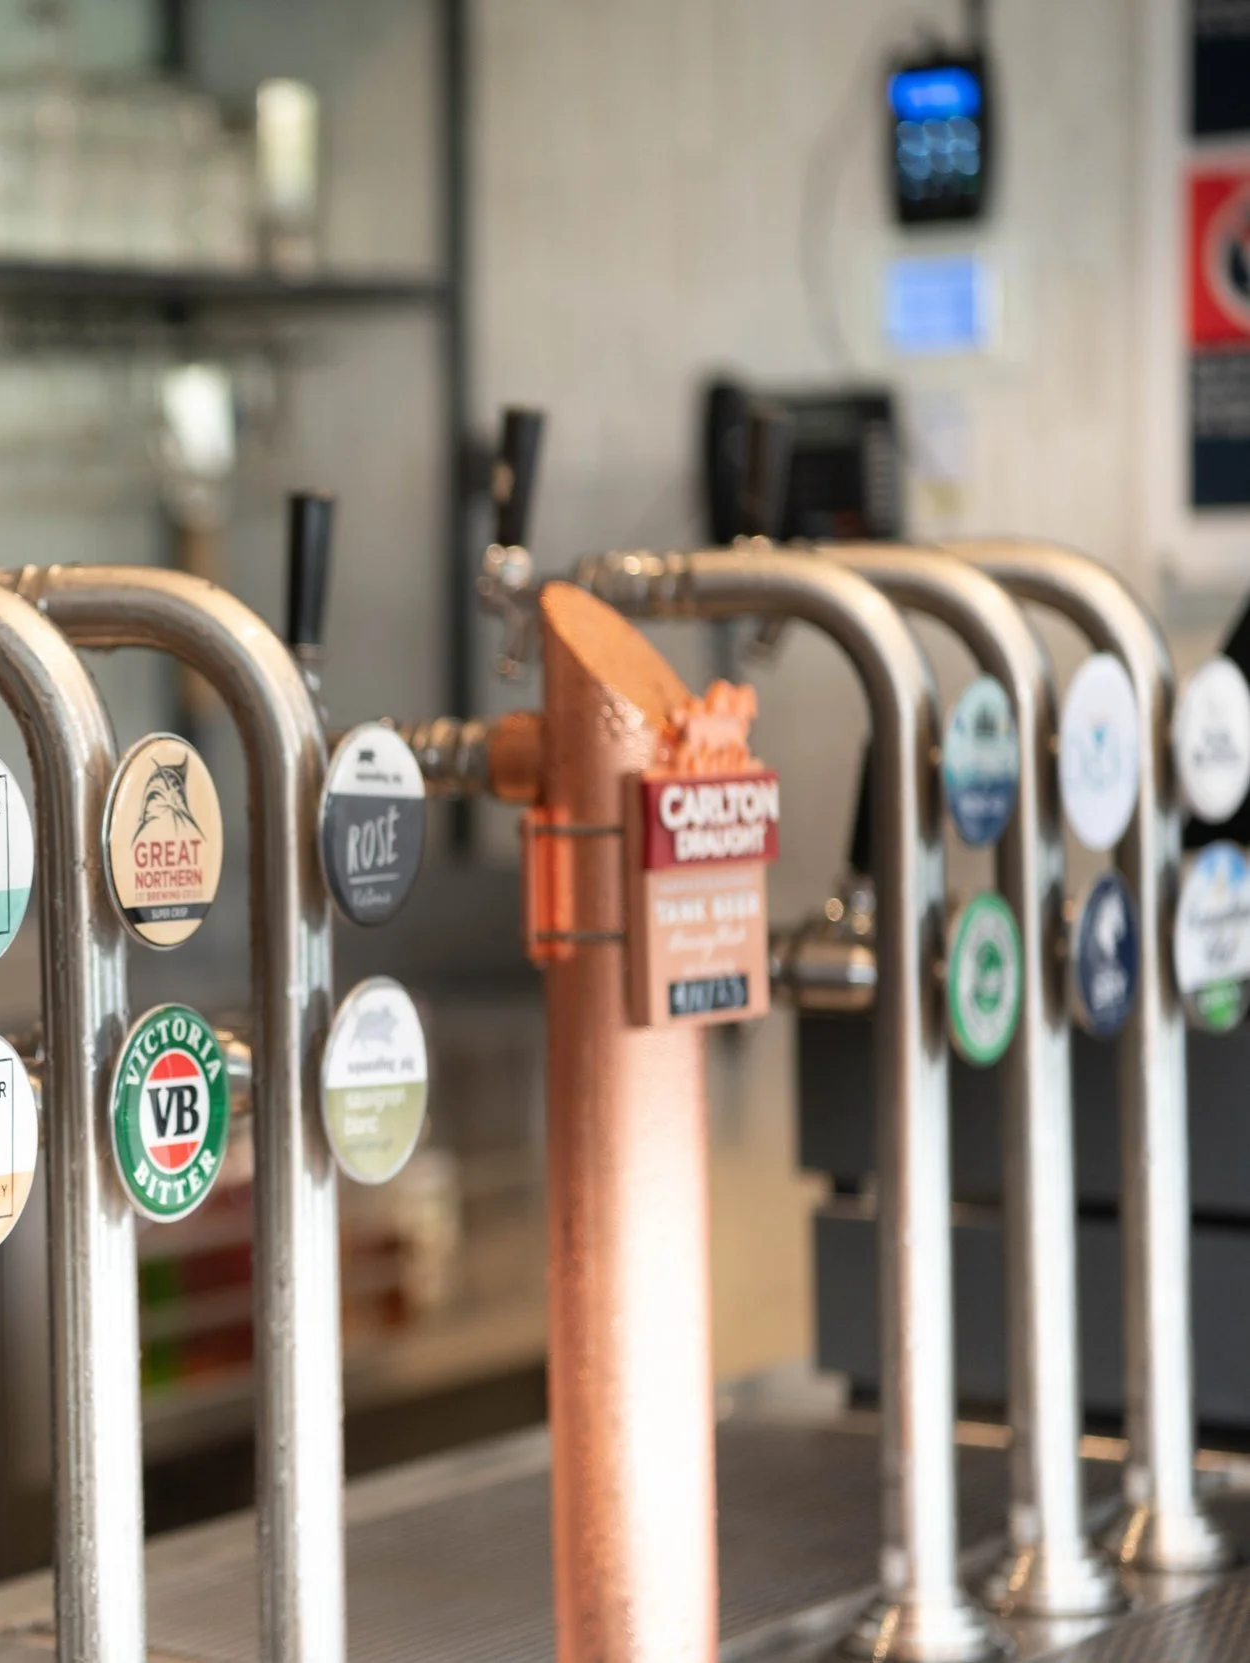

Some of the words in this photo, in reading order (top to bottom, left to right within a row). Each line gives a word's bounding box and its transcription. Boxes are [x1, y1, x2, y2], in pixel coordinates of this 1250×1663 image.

[659, 780, 779, 832] CARLTON
[134, 840, 202, 868] GREAT
[674, 826, 766, 862] DRAUGHT
[134, 869, 203, 890] NORTHERN
[125, 1017, 222, 1087] VICTORIA
[147, 1084, 200, 1139] VB
[133, 1149, 217, 1205] BITTER
